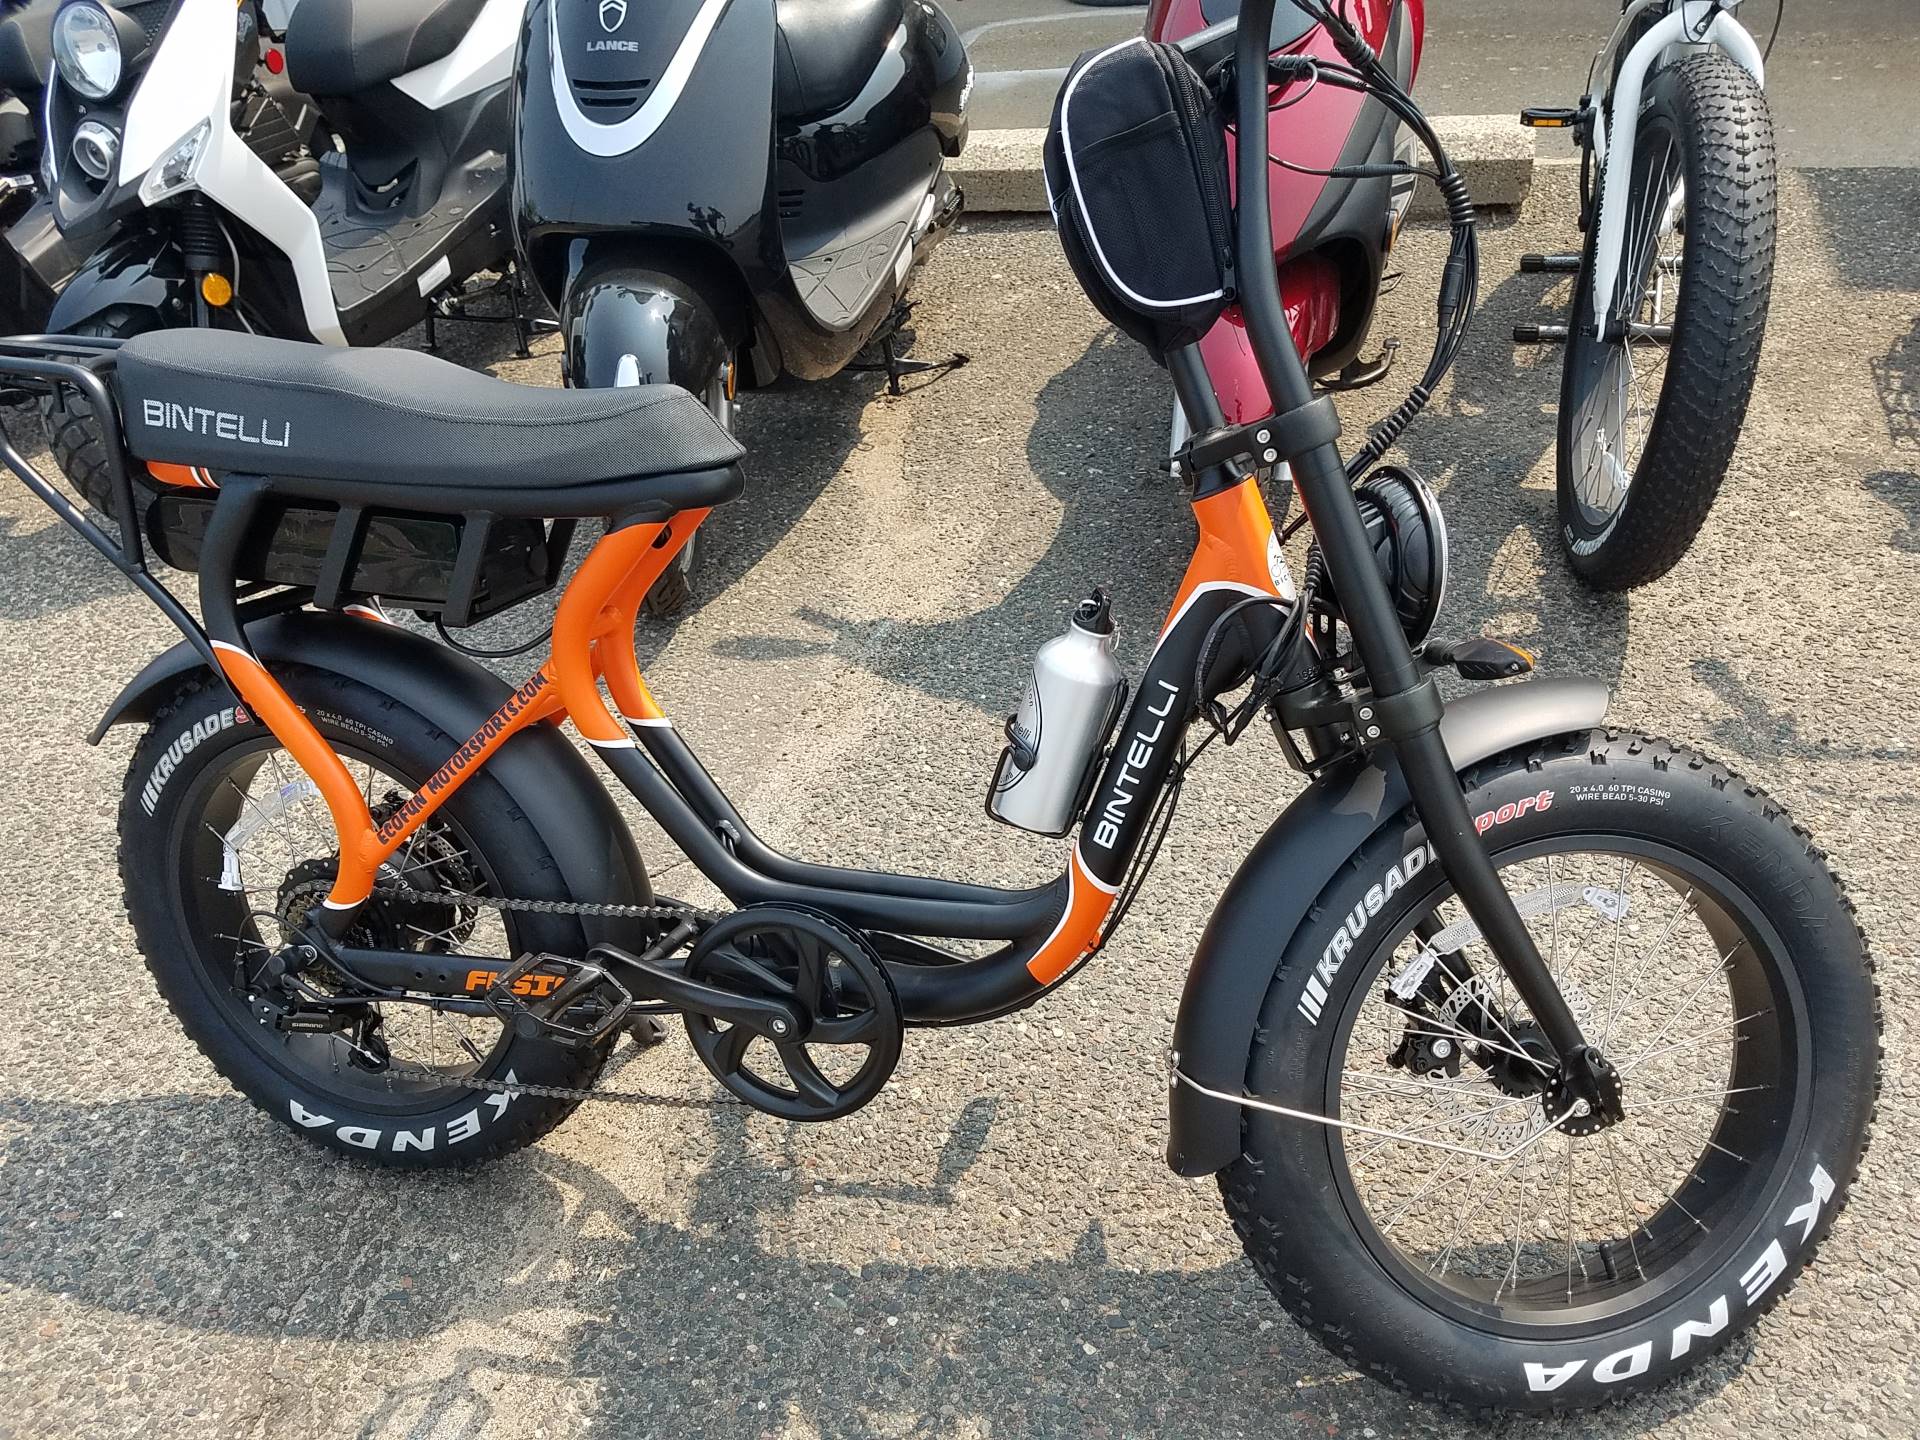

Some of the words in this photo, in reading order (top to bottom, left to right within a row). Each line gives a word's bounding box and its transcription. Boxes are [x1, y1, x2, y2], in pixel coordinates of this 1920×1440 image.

[586, 40, 639, 52] LANCE
[143, 399, 290, 447] BINTELLI
[149, 706, 234, 794] KRUSADE
[316, 709, 325, 717] 20
[354, 721, 366, 730] TPI
[367, 727, 394, 745] CASING
[321, 716, 339, 727] WIRE
[340, 722, 360, 734] BEAD
[376, 738, 388, 748] PSI
[376, 790, 428, 846] ECOFUN
[425, 671, 550, 795] MOTORSPORTS.COM
[1092, 679, 1180, 850] BINTELLI
[1569, 785, 1581, 794] 20
[1590, 784, 1604, 792] 4.0
[1608, 784, 1619, 792] 60
[1621, 784, 1636, 793] TPI
[1637, 786, 1671, 799] CASING
[1576, 793, 1600, 801] WIRE
[1602, 793, 1627, 801] BEAD
[1629, 794, 1648, 803] 5-30
[1649, 796, 1664, 806] PSI
[289, 1068, 521, 1152] KENDA
[1522, 1163, 1836, 1392] KENDA
